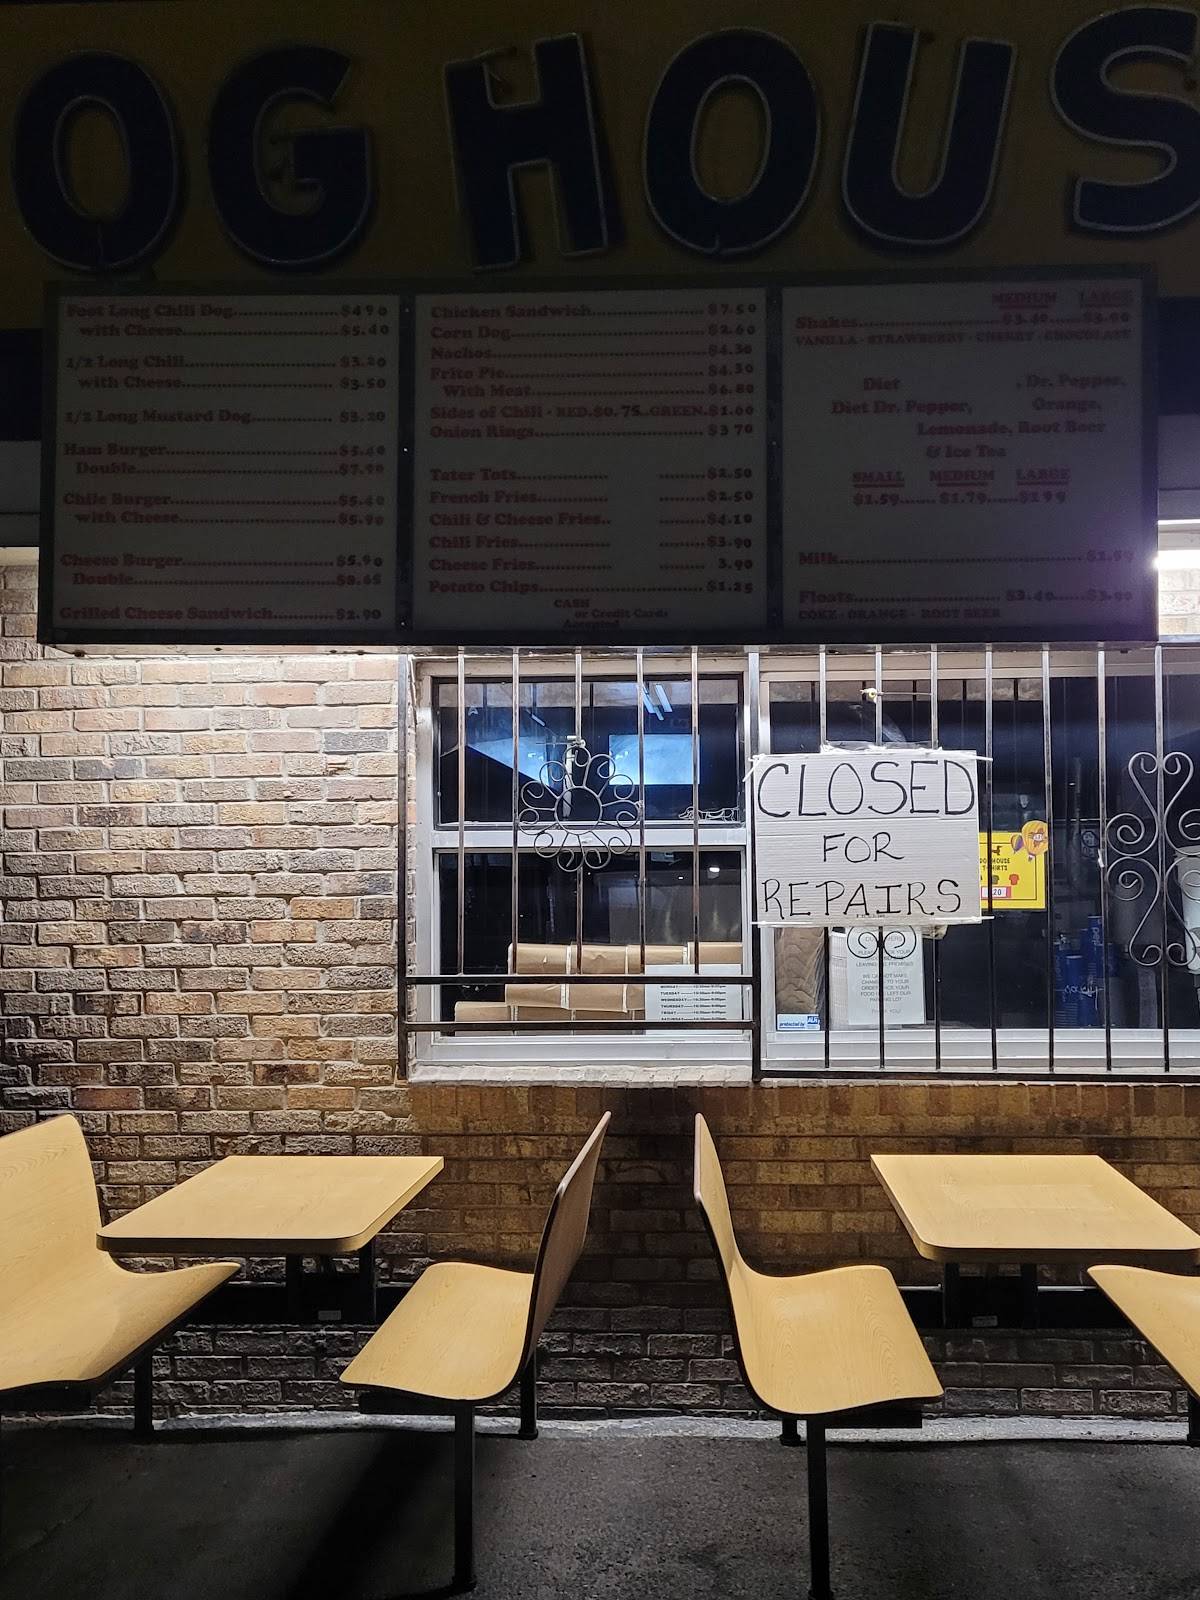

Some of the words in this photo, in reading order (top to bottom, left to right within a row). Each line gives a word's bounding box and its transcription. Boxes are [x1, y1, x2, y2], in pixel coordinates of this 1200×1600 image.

[443, 4, 1200, 274] HOUS
[795, 317, 859, 329] Shakes
[864, 378, 900, 390] Diet
[832, 401, 869, 414] Diet
[1019, 421, 1060, 434] Root
[1066, 421, 1105, 432] Beer
[946, 445, 971, 457] Ice
[977, 445, 1006, 457] Tea
[718, 558, 752, 570] 3.90
[799, 552, 838, 565] Milk
[800, 591, 855, 604] Floats
[758, 760, 974, 817] CLOSED
[823, 832, 904, 863] FOR
[762, 879, 961, 920] REPAIRS
